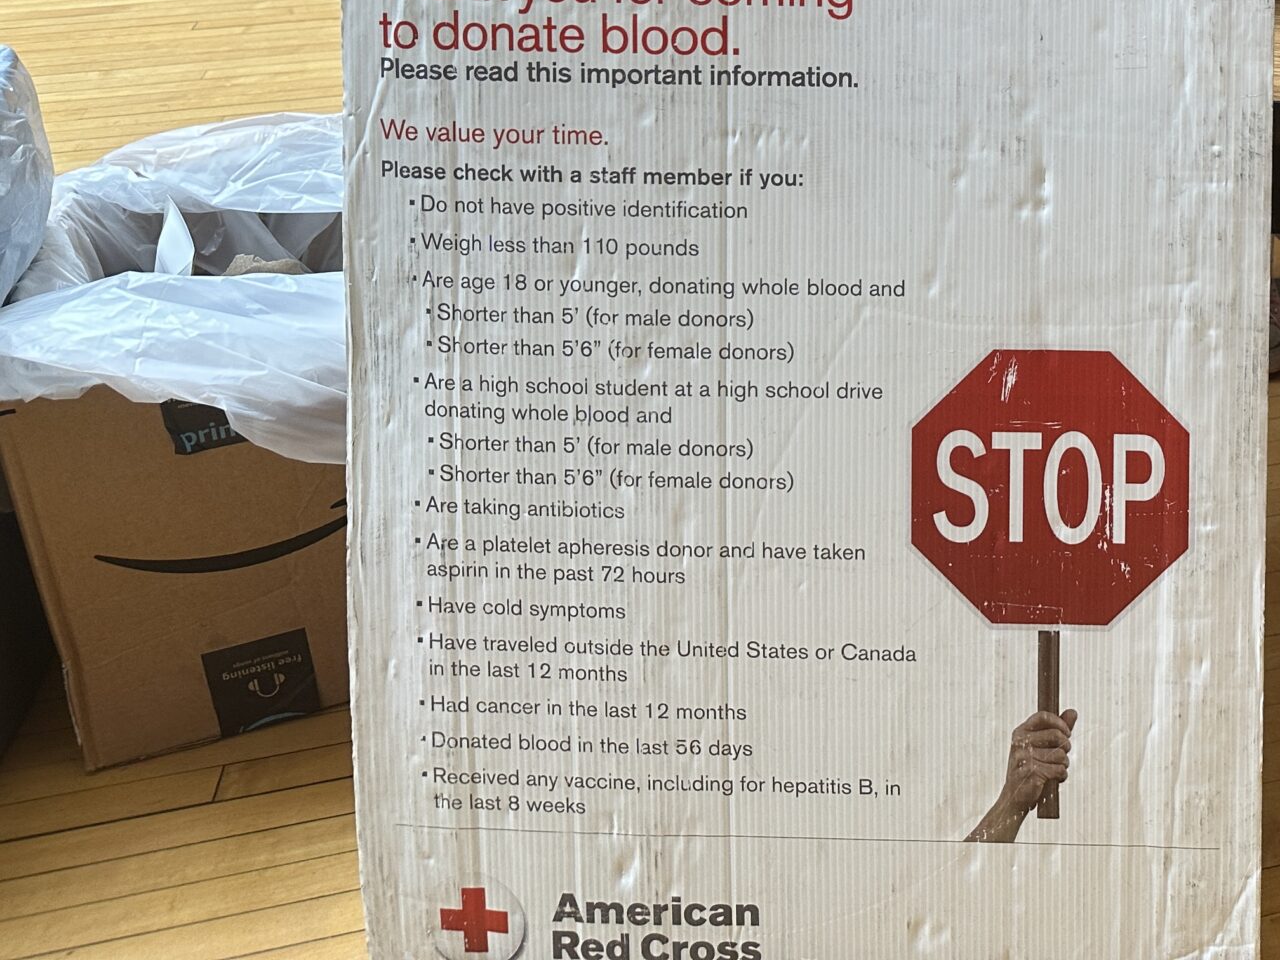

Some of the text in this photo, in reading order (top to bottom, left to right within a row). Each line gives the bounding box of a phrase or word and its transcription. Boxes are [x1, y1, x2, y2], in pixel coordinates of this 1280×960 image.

[379, 10, 739, 55] to donate blood.
[381, 57, 858, 88] Please read this important information.
[380, 119, 608, 149] We value your time.
[382, 160, 803, 189] Please check with a staff member if you:
[422, 195, 747, 220] Do not have positive identification
[421, 233, 699, 260] Weigh less than 110 pounds
[423, 271, 904, 299] Are age 18 or younger, donating whole blood and
[438, 336, 507, 354] Shorter
[514, 339, 554, 356] than
[609, 340, 641, 361] (for
[648, 342, 711, 359] female
[719, 342, 794, 363] donors)
[933, 429, 1165, 545] STOP
[426, 496, 624, 520] Are taking antibiotics
[427, 533, 865, 560] Are a platelet apheresis donor and have taken
[429, 596, 625, 622] Have cold symptoms
[430, 633, 916, 661] Have traveled outside the United States or Canada
[222, 661, 275, 681] listening
[432, 731, 752, 760] Donated blood in the last 56 days
[434, 767, 900, 798] Received any vaccine, including for hepatitis B, in
[553, 893, 759, 926] American
[553, 931, 761, 960] Red Cross
